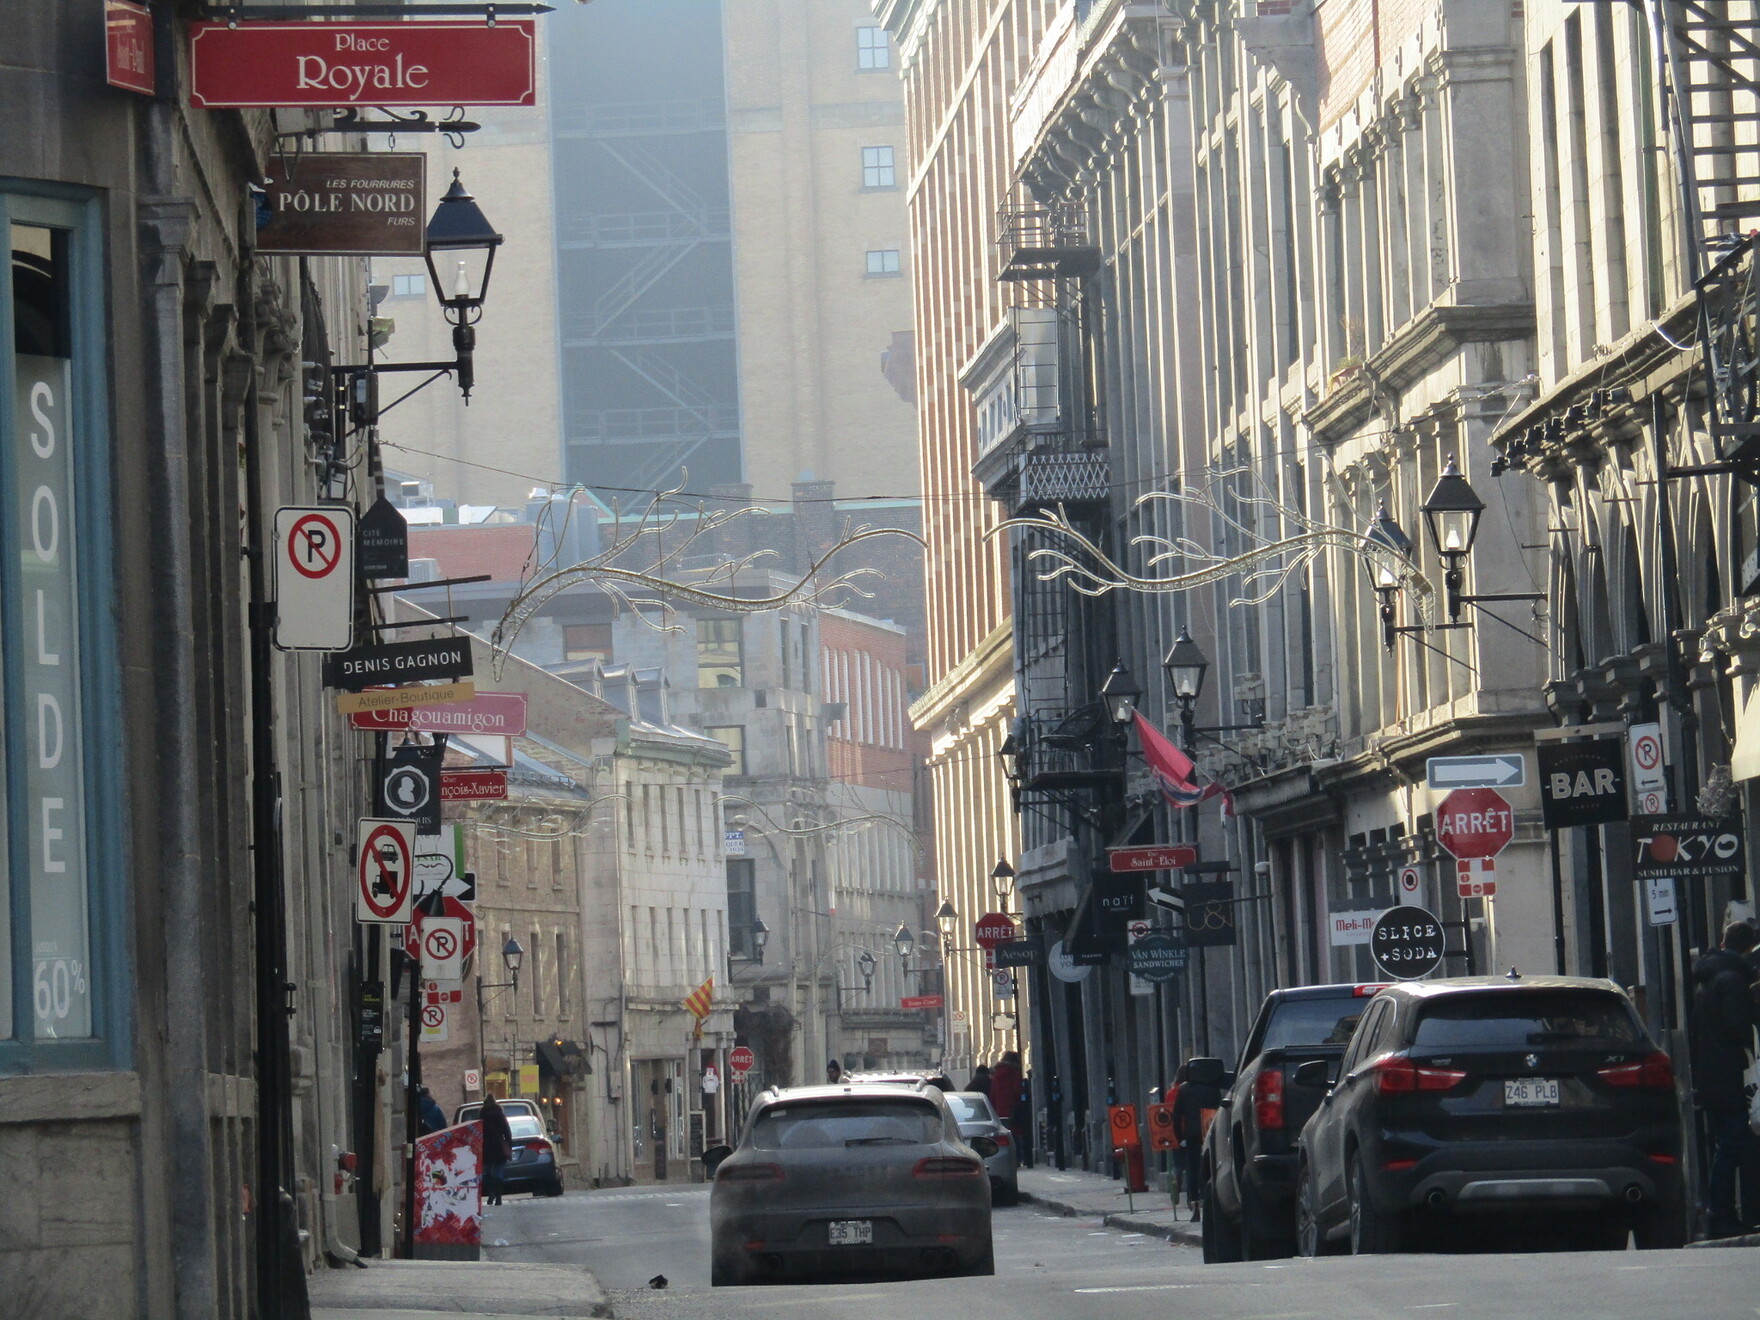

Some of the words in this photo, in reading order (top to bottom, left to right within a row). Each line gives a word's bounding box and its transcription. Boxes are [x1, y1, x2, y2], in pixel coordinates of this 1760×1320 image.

[335, 32, 390, 51] Place
[296, 52, 429, 101] Royale
[326, 179, 347, 189] LES
[350, 179, 415, 189] FOURRURES
[278, 190, 343, 212] PÔLE
[351, 193, 415, 212] NORD
[387, 217, 415, 226] FURS
[30, 381, 66, 873] SOLDE
[343, 658, 390, 675] DENIS
[395, 651, 462, 670] GAGNON
[371, 706, 505, 732] Chagouamigon
[441, 782, 505, 798] nçois-Xavier
[1551, 768, 1617, 800] BAR
[1441, 808, 1509, 836] ARRÊT
[1652, 820, 1721, 832] RESTAURANT
[1637, 868, 1668, 878] SUSHI
[1669, 867, 1690, 877] BAR
[1692, 866, 1700, 875] &
[1702, 865, 1739, 876] FUSION
[1102, 894, 1134, 907] naïf
[977, 924, 1013, 939] ARRÊT
[1378, 924, 1437, 941] SLICE
[1001, 949, 1038, 962] Aesop
[1133, 960, 1184, 969] SANDWICHES
[1506, 1085, 1528, 1099] Z46
[1535, 1085, 1558, 1098] PLB
[854, 1226, 871, 1238] THP
